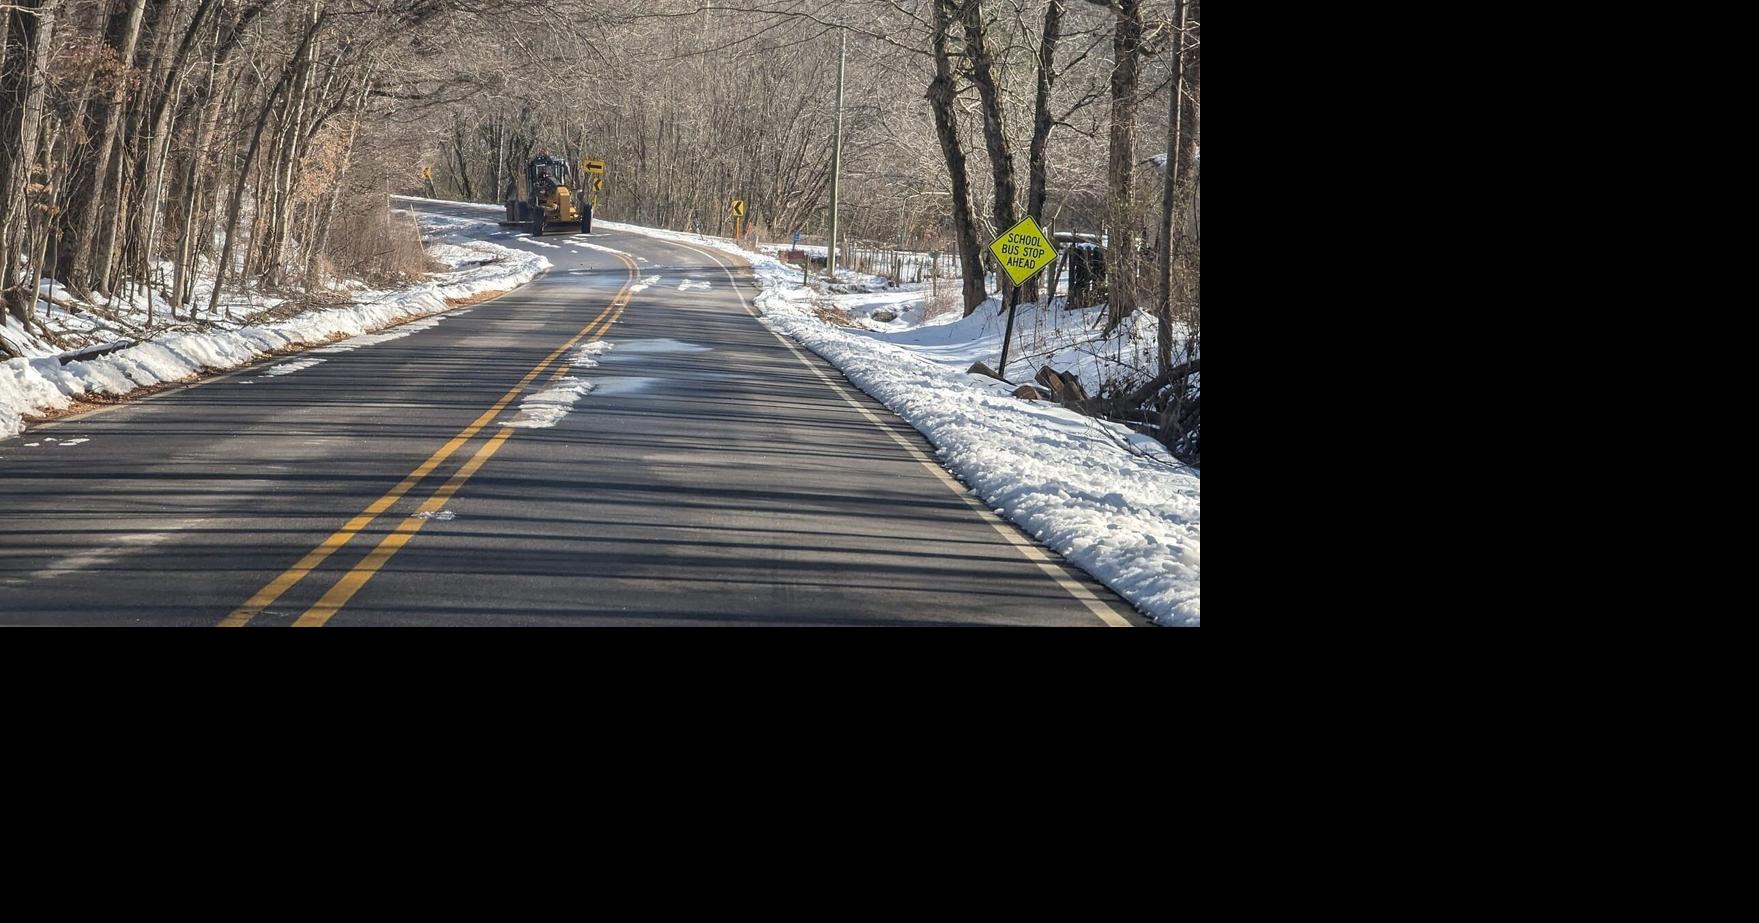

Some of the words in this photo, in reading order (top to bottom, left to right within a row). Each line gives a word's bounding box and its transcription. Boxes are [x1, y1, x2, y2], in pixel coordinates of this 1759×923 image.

[1008, 233, 1041, 247] SCHOOL
[1002, 244, 1019, 255] BUS
[1023, 247, 1045, 258] STOP
[1007, 257, 1035, 269] AHEAD
